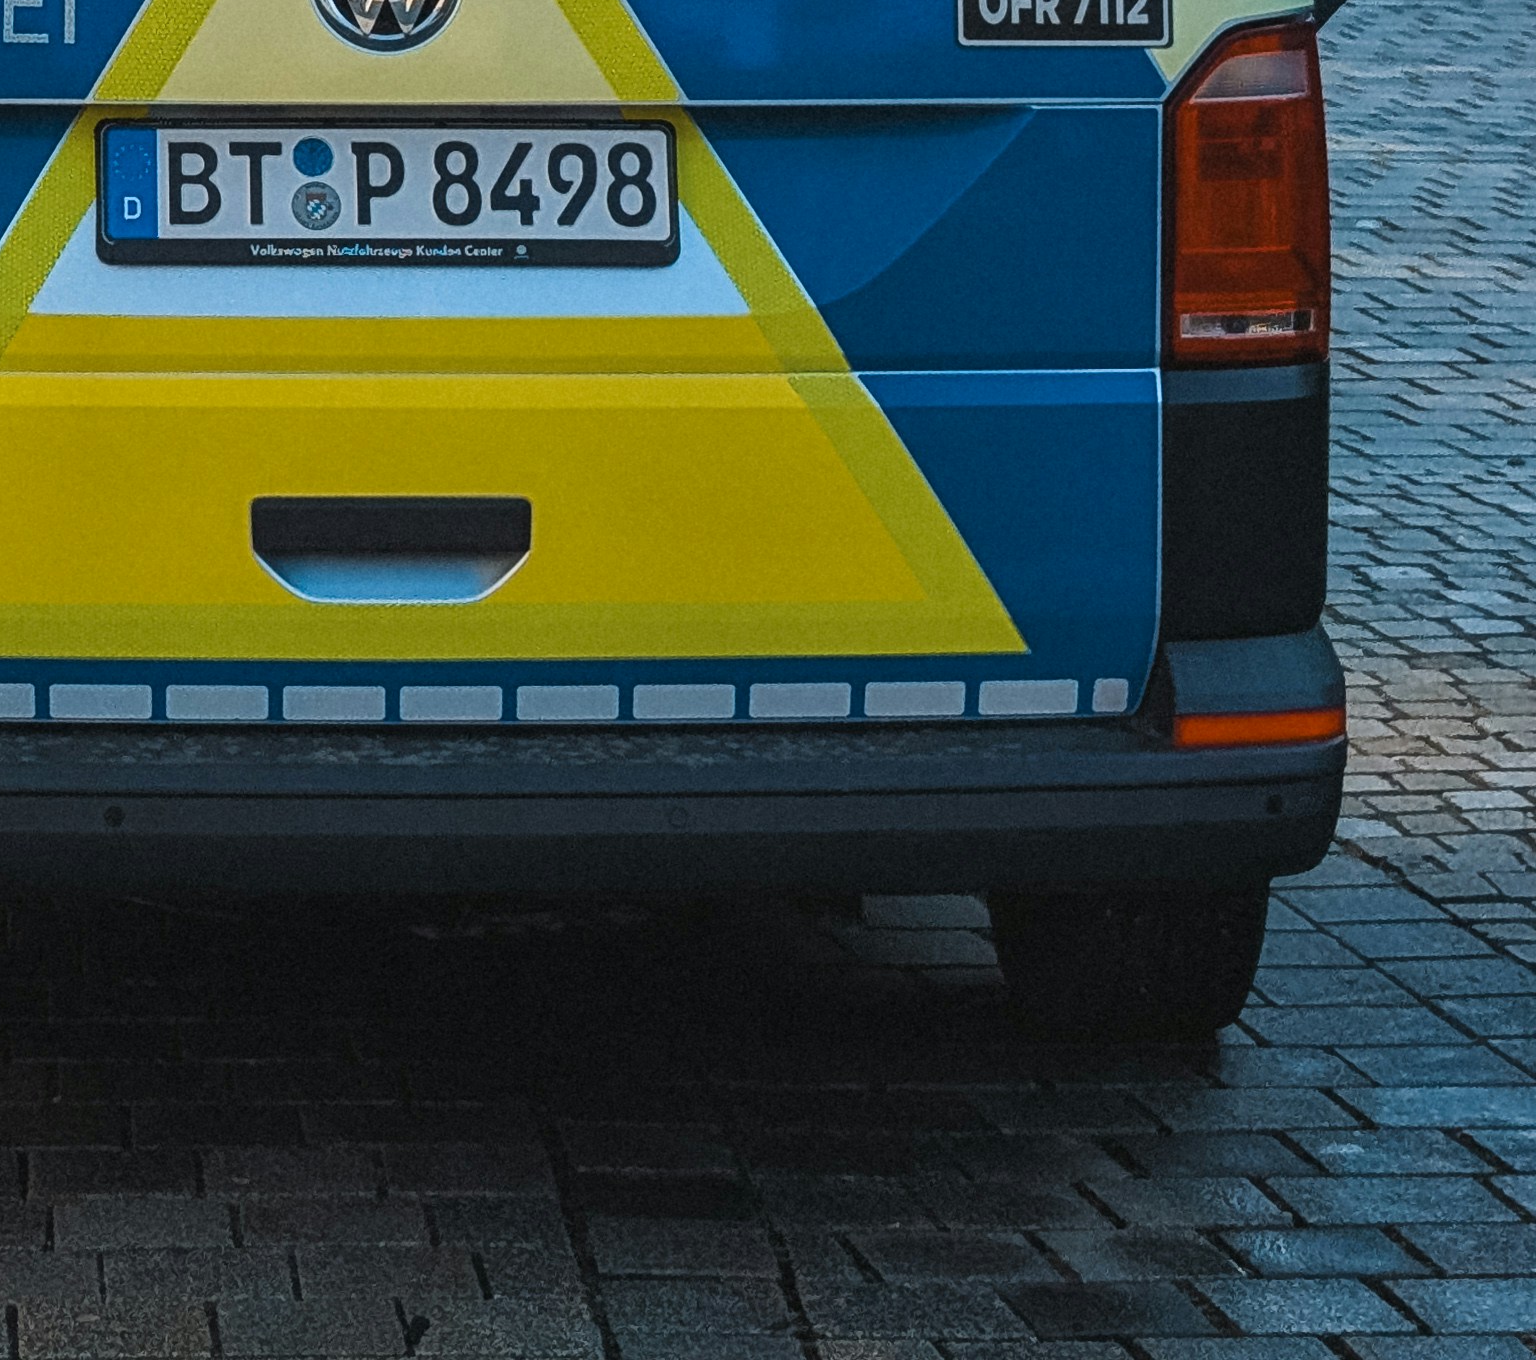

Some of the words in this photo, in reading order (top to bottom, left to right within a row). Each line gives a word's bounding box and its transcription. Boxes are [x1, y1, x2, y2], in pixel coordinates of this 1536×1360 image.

[123, 196, 142, 220] D
[167, 141, 283, 226] BT
[350, 141, 405, 226] P
[433, 140, 657, 228] 8498
[250, 244, 324, 258] Volkswagen
